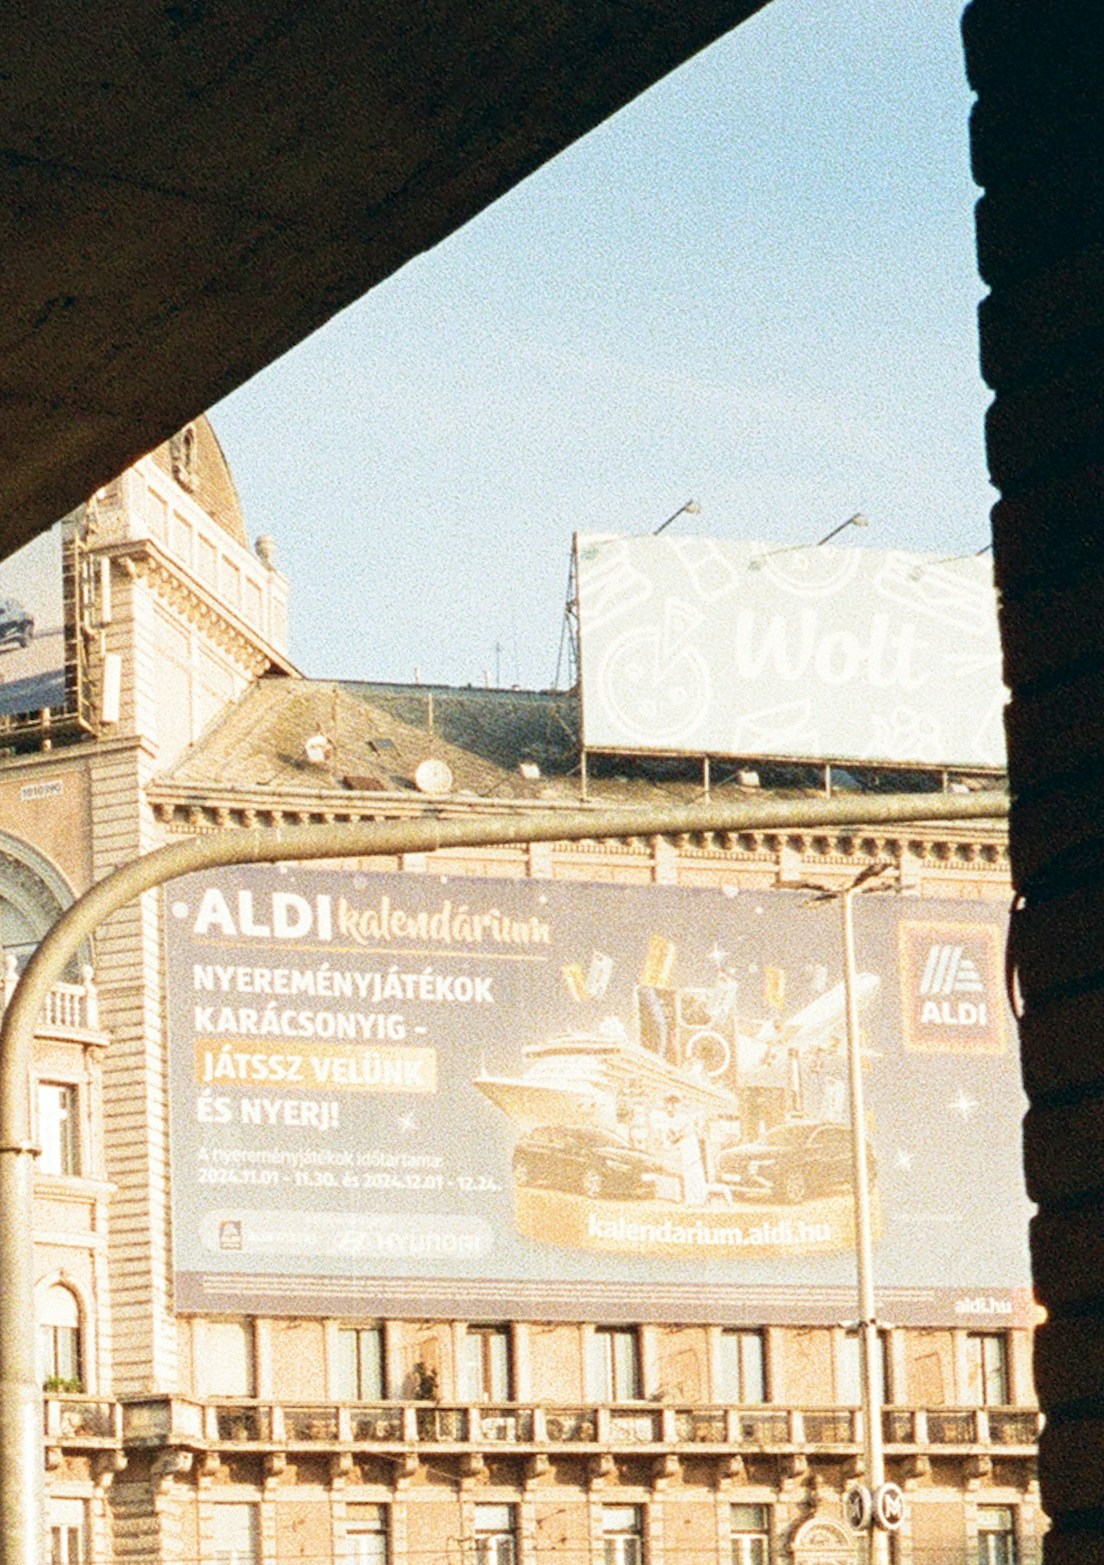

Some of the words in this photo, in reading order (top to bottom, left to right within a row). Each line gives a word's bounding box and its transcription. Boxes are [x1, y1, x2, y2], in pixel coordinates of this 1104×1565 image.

[732, 607, 932, 690] Wolt
[194, 888, 332, 942] ALDI
[337, 897, 551, 947] kalendárium
[193, 963, 495, 1003] NYEREMÉNYJÁTÉKOK
[193, 1003, 407, 1039] KARÁCSONYIG
[920, 1000, 988, 1026] ALDI
[203, 1046, 304, 1083] JÁTSSZ
[310, 1053, 425, 1087] VELÜNK
[196, 1088, 232, 1124] ÉS
[241, 1099, 340, 1131] NYERJ!
[587, 1213, 832, 1246] kalendarium.aldi.hu
[954, 1296, 1013, 1315] aldi.hu
[884, 1493, 903, 1519] M
